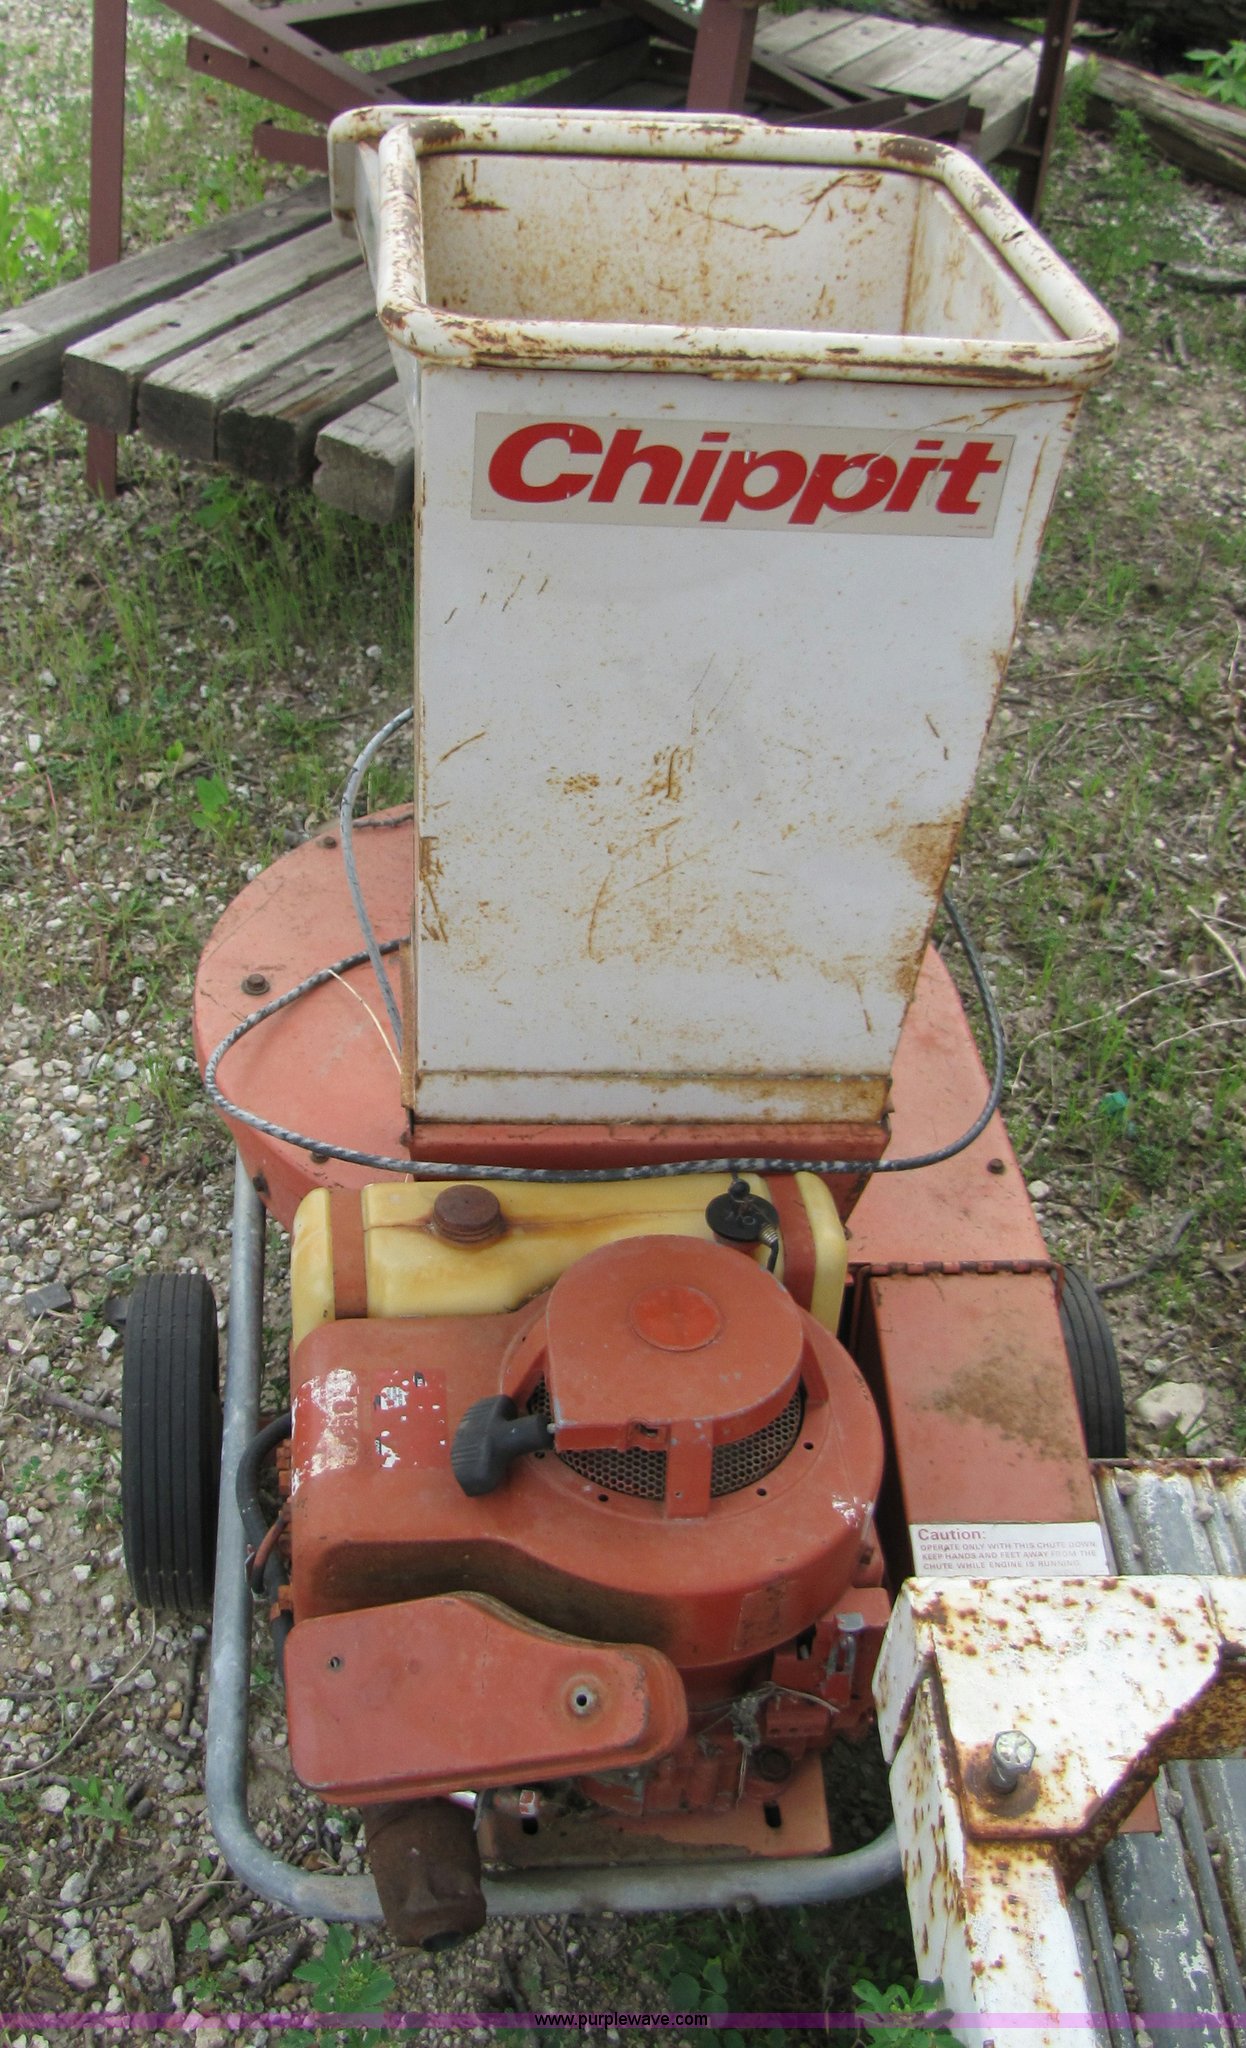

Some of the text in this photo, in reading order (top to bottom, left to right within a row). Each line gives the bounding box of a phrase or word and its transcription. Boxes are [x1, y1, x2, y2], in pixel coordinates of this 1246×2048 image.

[487, 421, 1003, 525] Chippit
[917, 1528, 987, 1541] Caution:
[920, 1544, 960, 1552] OPERATE
[962, 1543, 985, 1551] ONLY
[987, 1542, 1012, 1550] WITH
[921, 1553, 944, 1561] KEEP
[945, 1552, 977, 1560] HANDS
[999, 1551, 1021, 1559] FEET
[1022, 1551, 1049, 1559] AWAY
[1079, 1549, 1097, 1557] THE
[923, 1562, 953, 1570] CHUTE
[956, 1561, 986, 1569] WHILE
[988, 1561, 1023, 1569] ENGINE
[1025, 1560, 1035, 1568] IS
